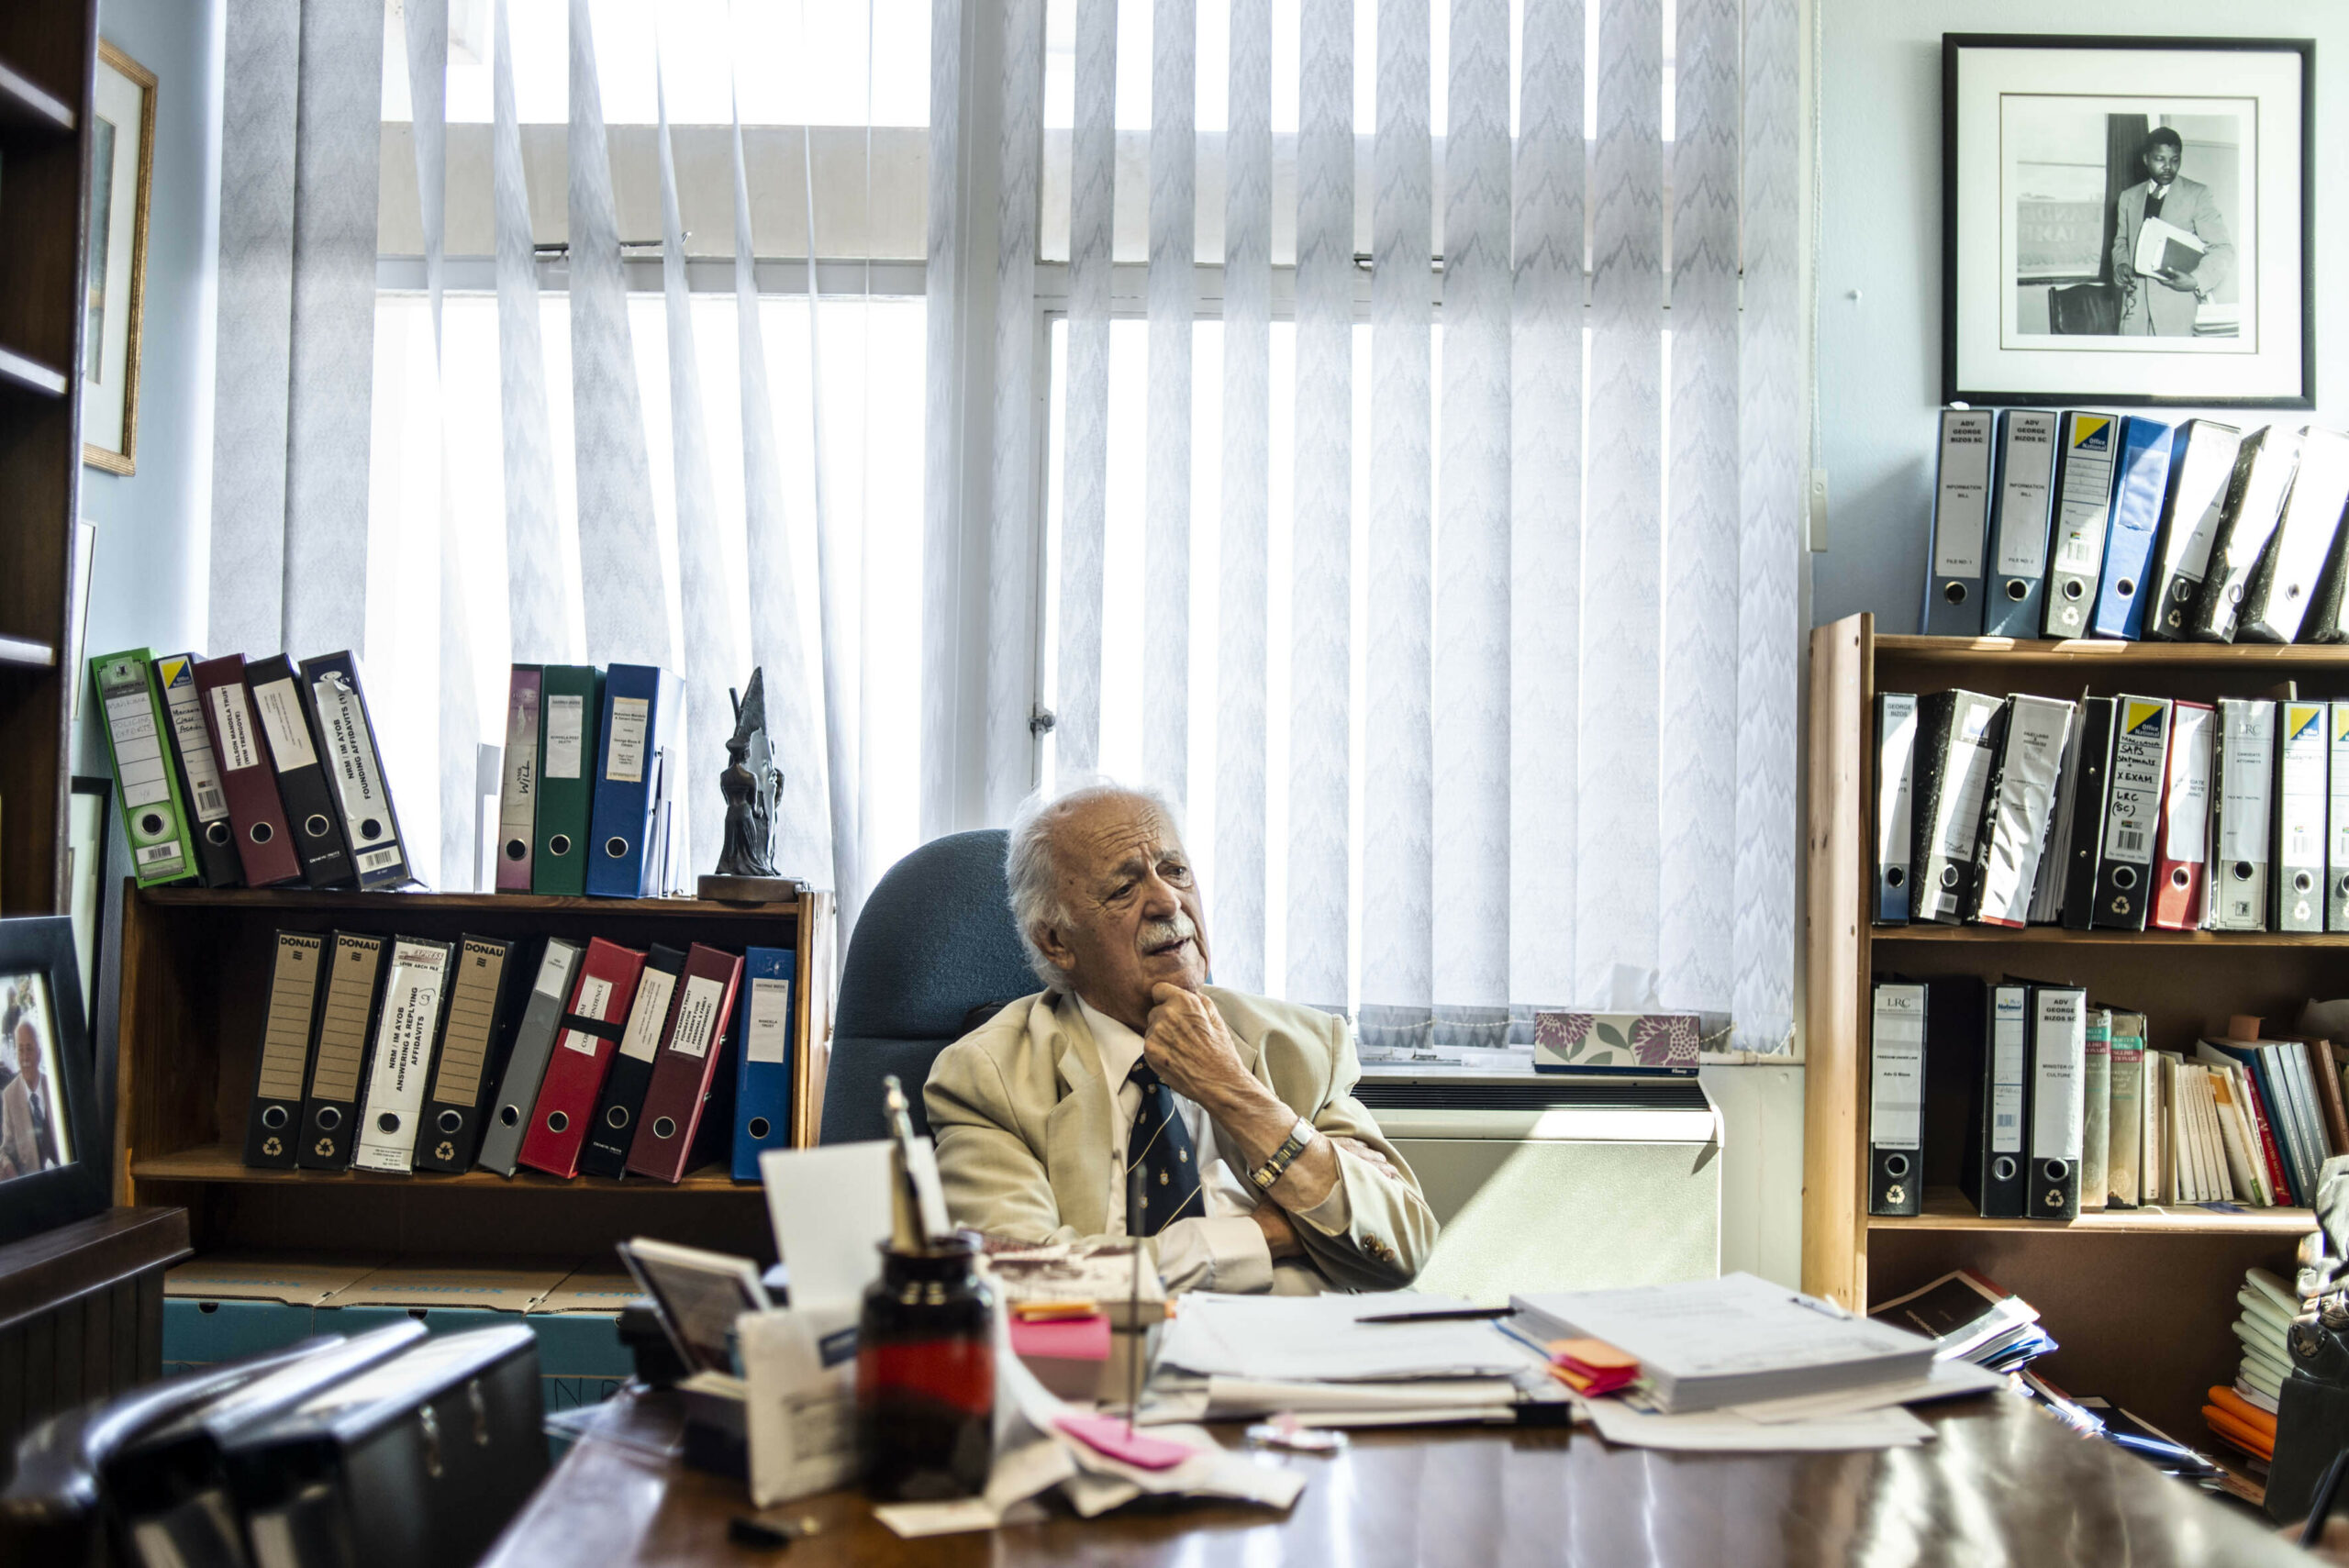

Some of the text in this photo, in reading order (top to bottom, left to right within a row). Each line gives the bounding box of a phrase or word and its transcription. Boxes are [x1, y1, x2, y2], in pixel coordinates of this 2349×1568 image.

[2082, 442, 2107, 451] National
[2088, 437, 2106, 445] Office
[221, 687, 242, 767] NELSON MANDELA TRUST
[235, 711, 248, 749] TRENGOVE)
[333, 718, 345, 742] AYOB
[343, 706, 359, 754] AFFIDAVITS
[2134, 728, 2161, 737] National
[340, 743, 348, 754] IM
[343, 760, 354, 780] NRM
[355, 754, 372, 800] FOUNDING
[519, 761, 530, 795] WILL
[2125, 773, 2153, 784] EXAM
[2117, 791, 2139, 802] LRC
[2112, 801, 2136, 817] (SC)
[280, 936, 320, 951] DONAU
[339, 937, 379, 951] DONAU
[464, 942, 506, 958] DONAU
[1887, 998, 1911, 1007] LRC
[395, 1006, 405, 1030] AYOB
[678, 1006, 686, 1029] MANDELA
[681, 1011, 692, 1041] FOUNDATION
[395, 1032, 400, 1043] IM
[395, 1040, 409, 1092] ANSWERING
[406, 987, 418, 1030] REPLYING
[692, 1018, 700, 1044] PERSONAL
[411, 1016, 425, 1066] AFFIDAVITS
[389, 1050, 397, 1069] NRM
[371, 1285, 503, 1296] COMBOX
